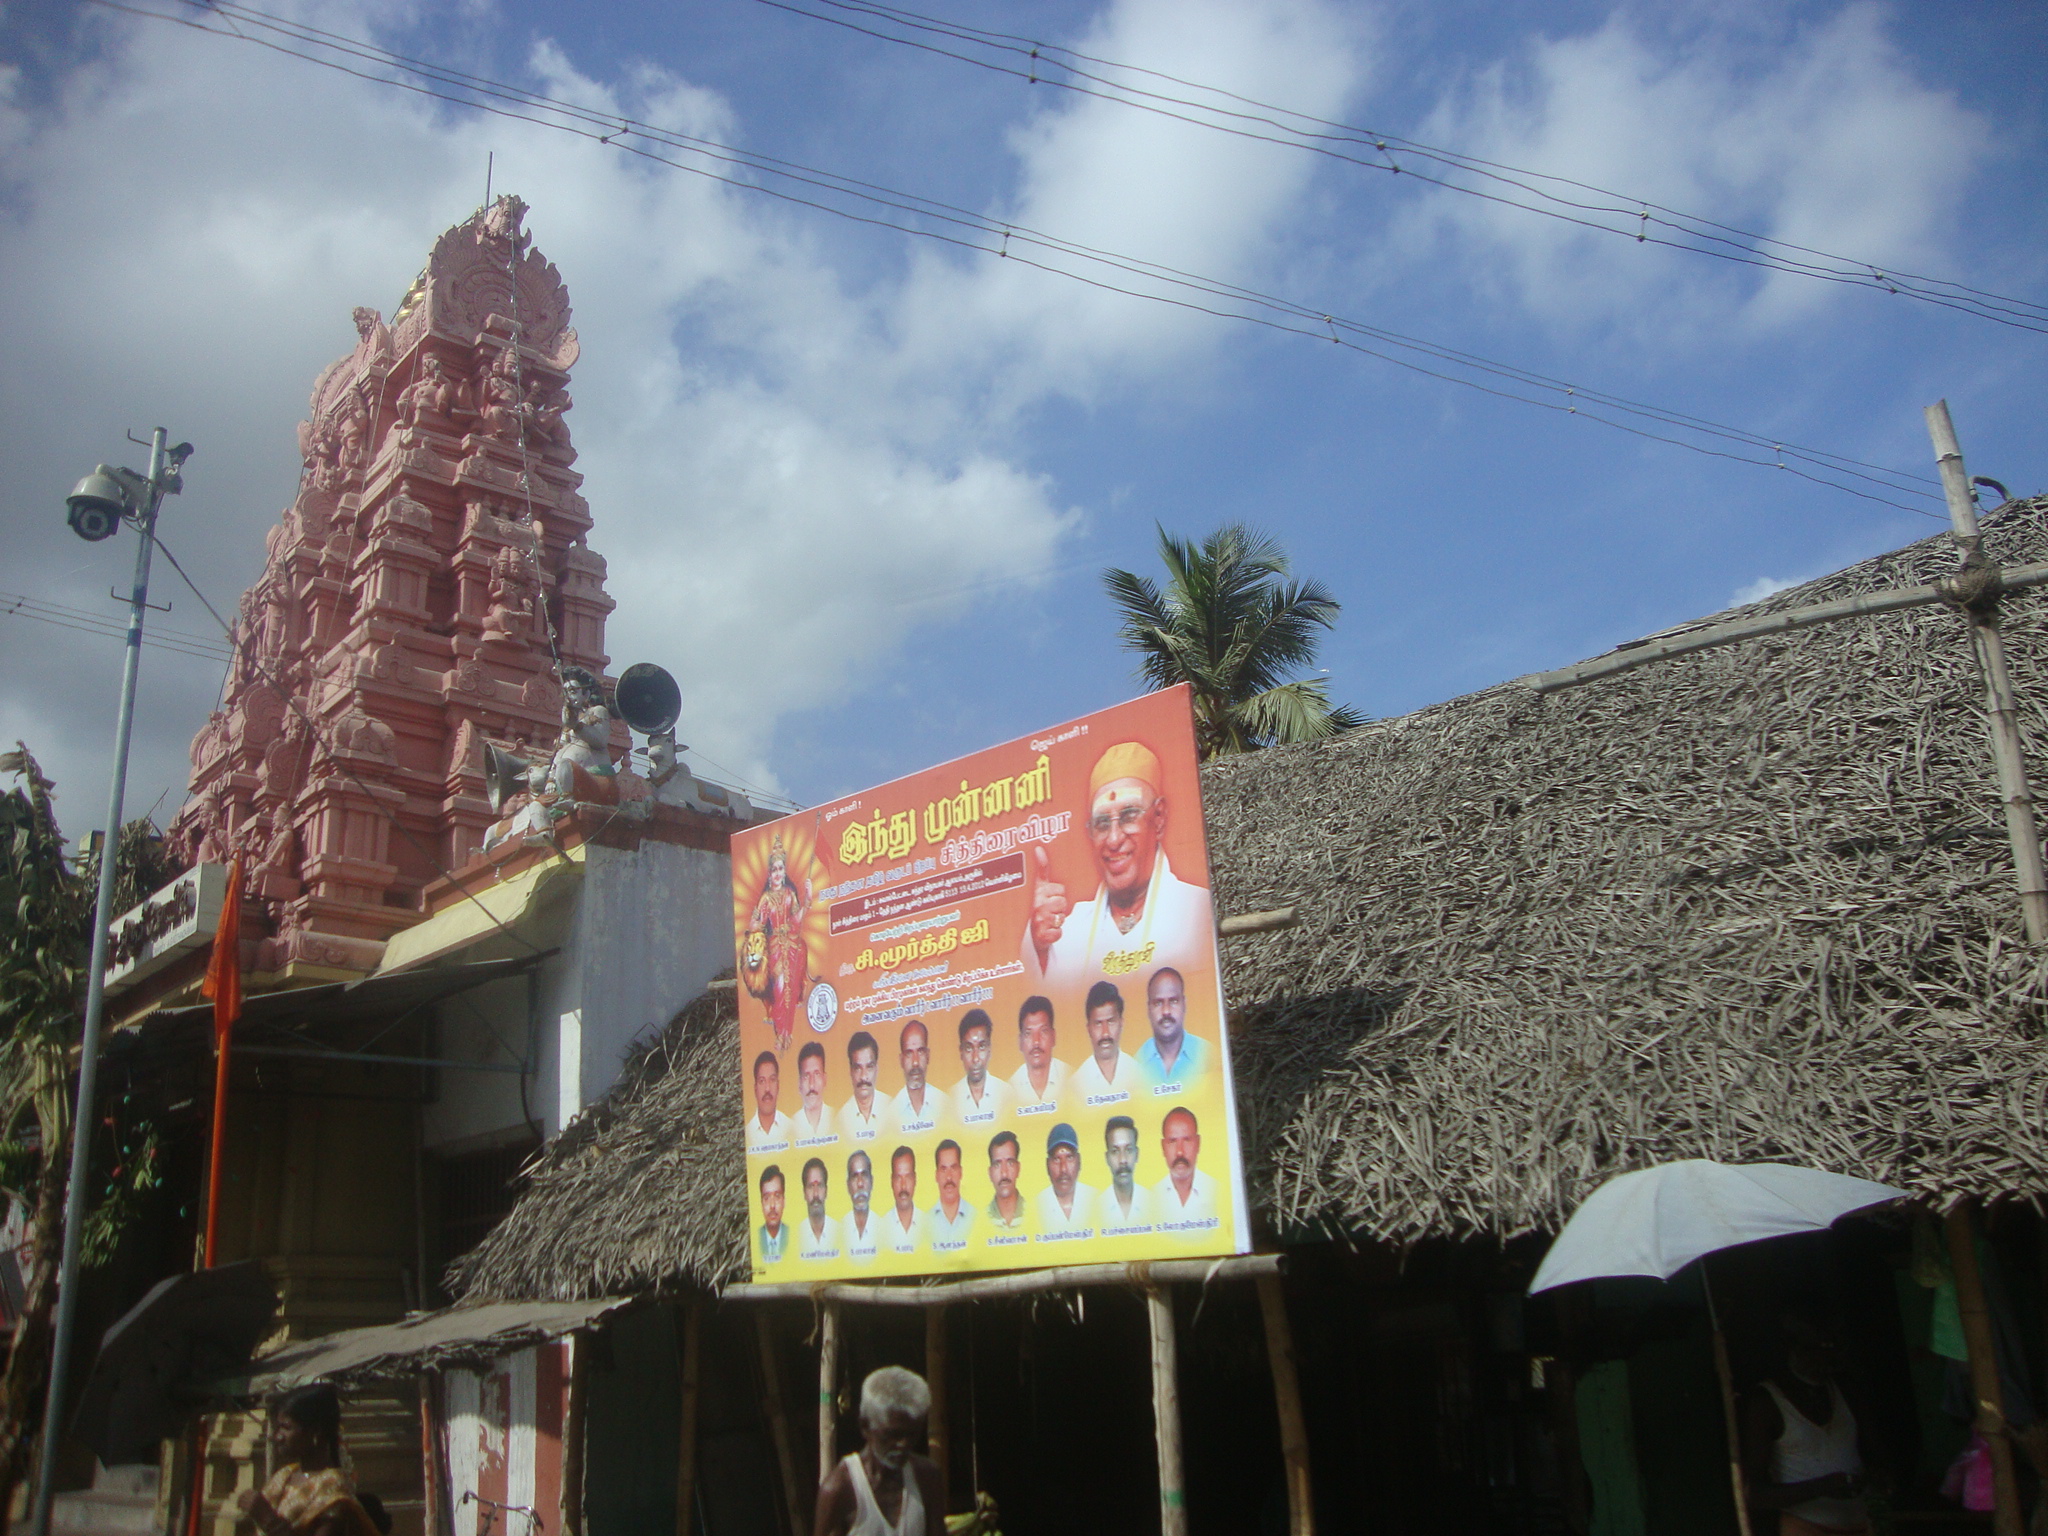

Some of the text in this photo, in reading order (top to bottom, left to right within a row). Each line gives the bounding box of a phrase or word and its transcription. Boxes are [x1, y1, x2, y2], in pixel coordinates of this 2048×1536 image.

[1030, 735, 1055, 751] ஜெய்
[1056, 725, 1079, 742] காளி
[825, 807, 838, 821] ஓம்
[838, 800, 857, 814] காளி
[839, 808, 916, 866] இந்து
[855, 927, 957, 971] சி.மூர்த்தி
